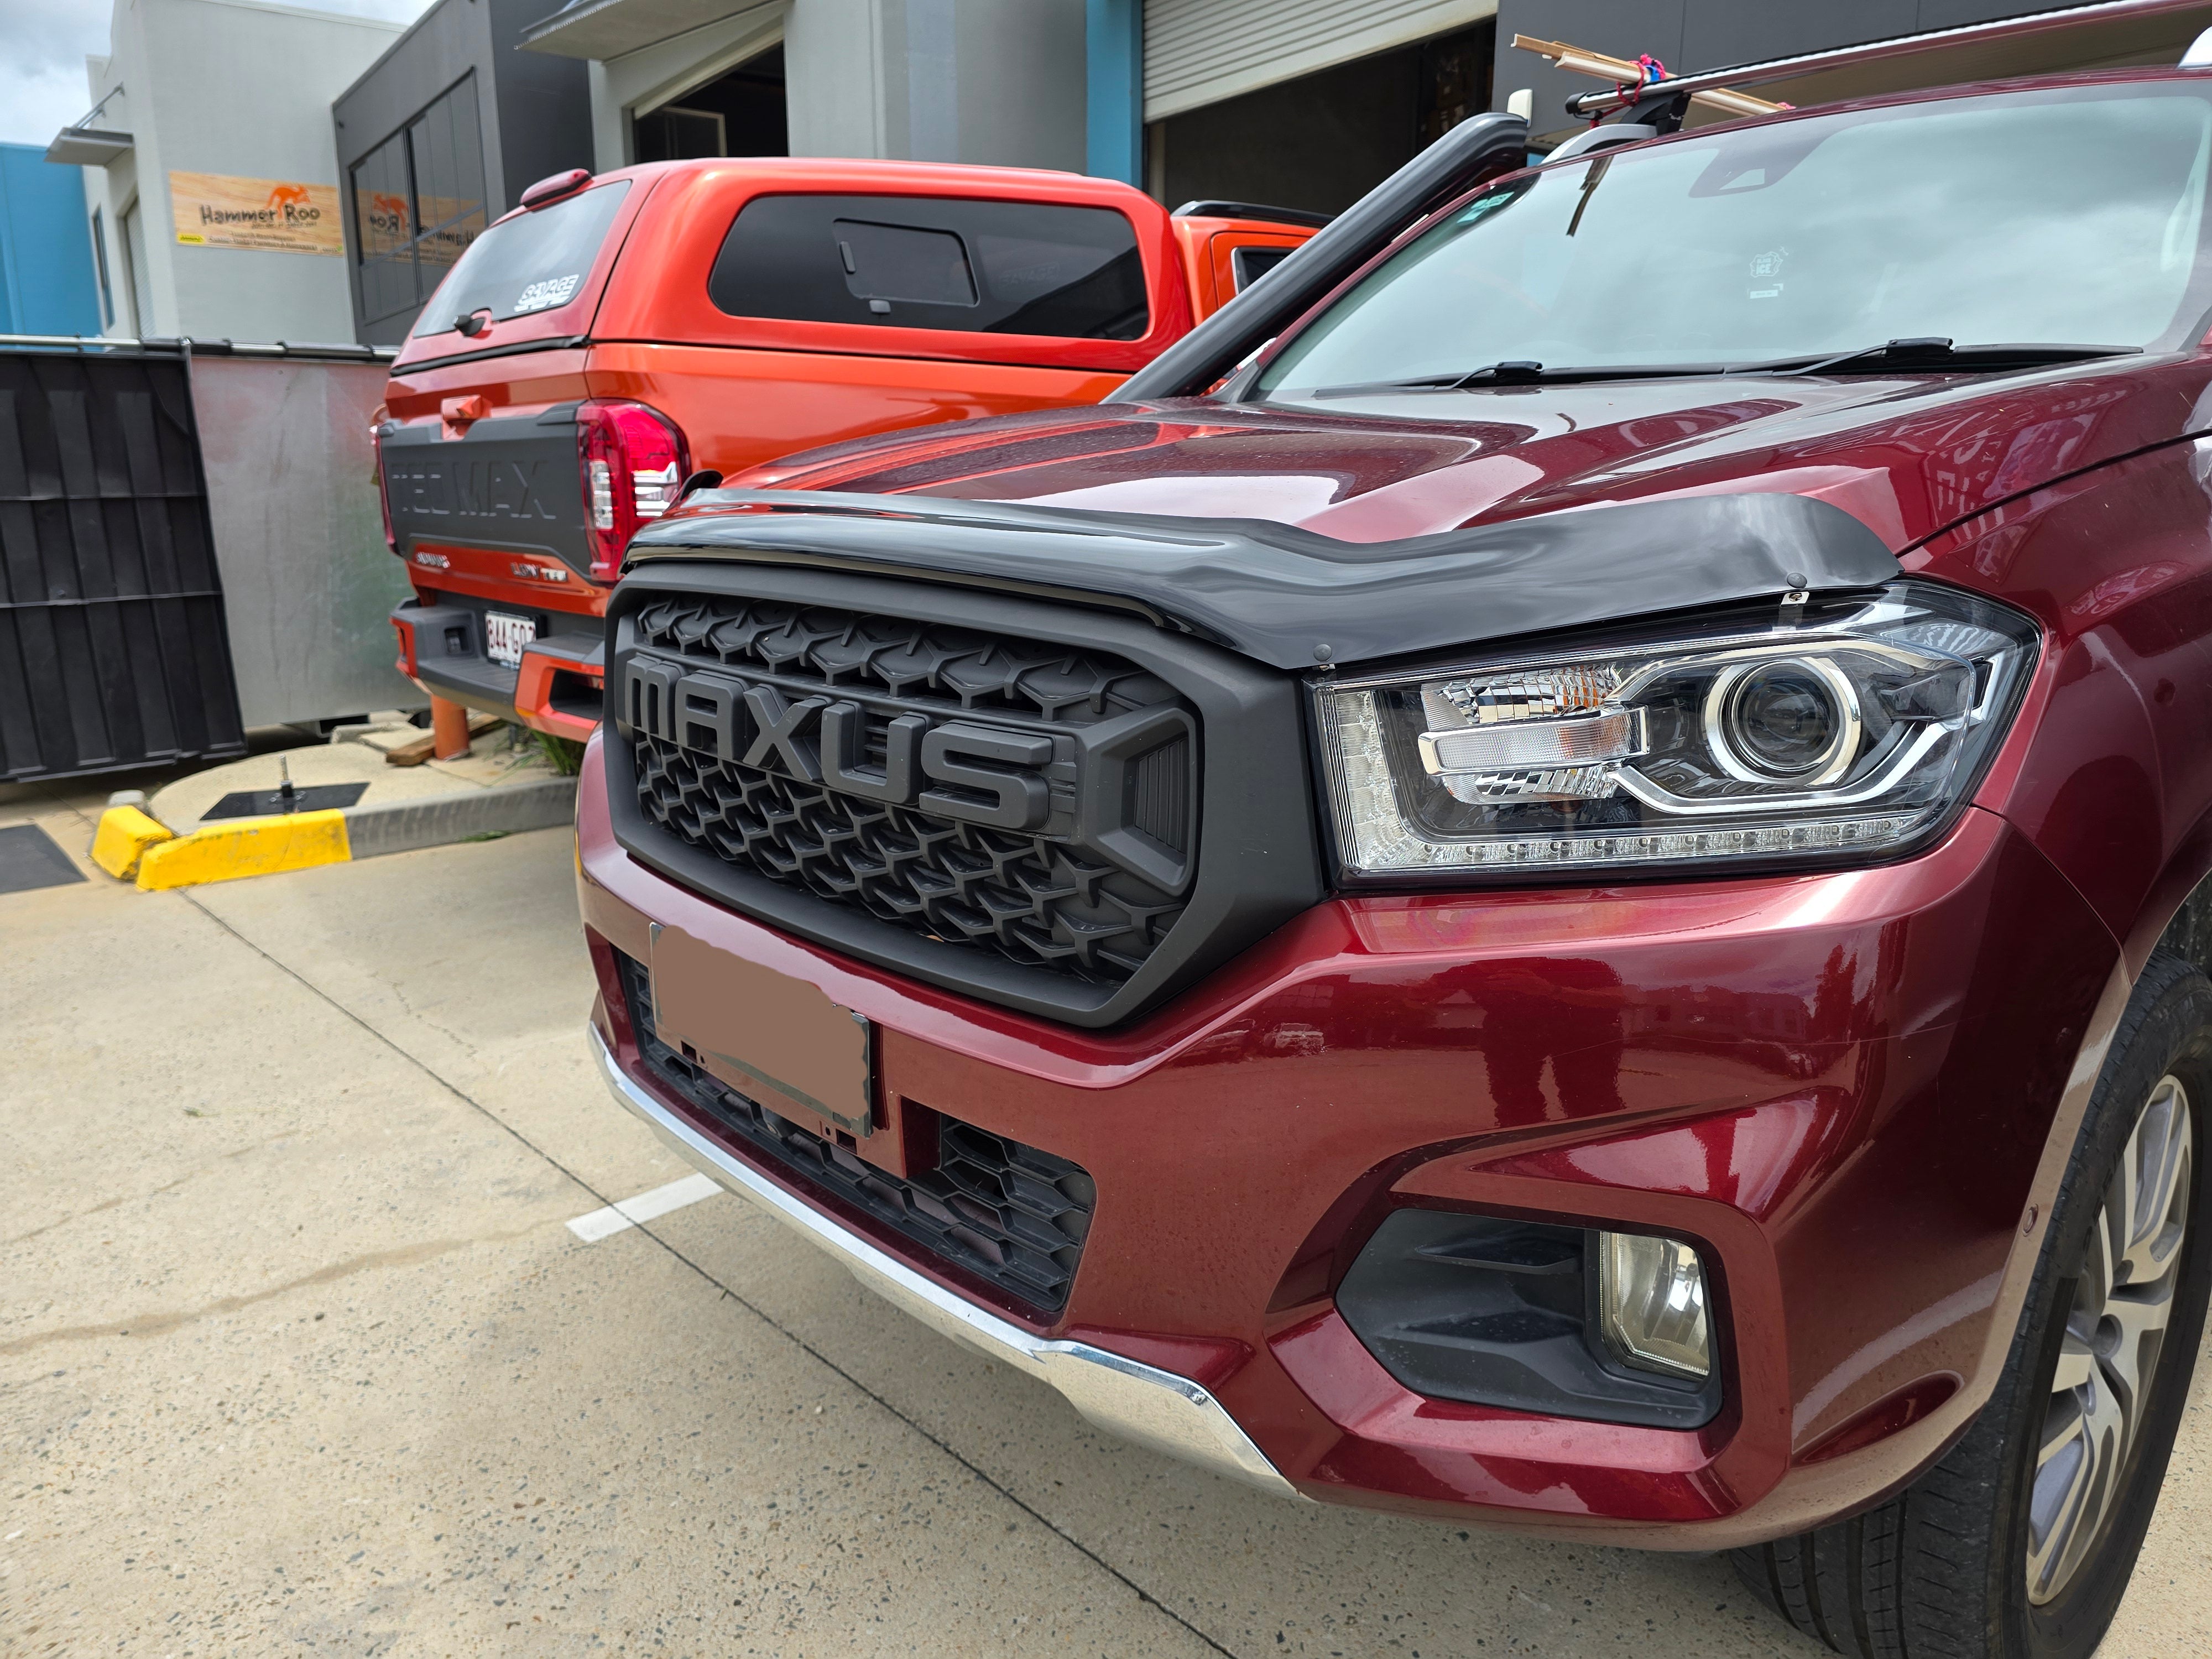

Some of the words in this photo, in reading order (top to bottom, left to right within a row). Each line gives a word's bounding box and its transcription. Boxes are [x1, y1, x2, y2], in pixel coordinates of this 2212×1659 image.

[199, 204, 277, 226] Hammer
[284, 203, 321, 222] Roo
[1756, 263, 1771, 275] ICE
[521, 274, 579, 302] SAVAGE
[452, 460, 557, 520] MAX
[625, 653, 1055, 831] MAXUS
